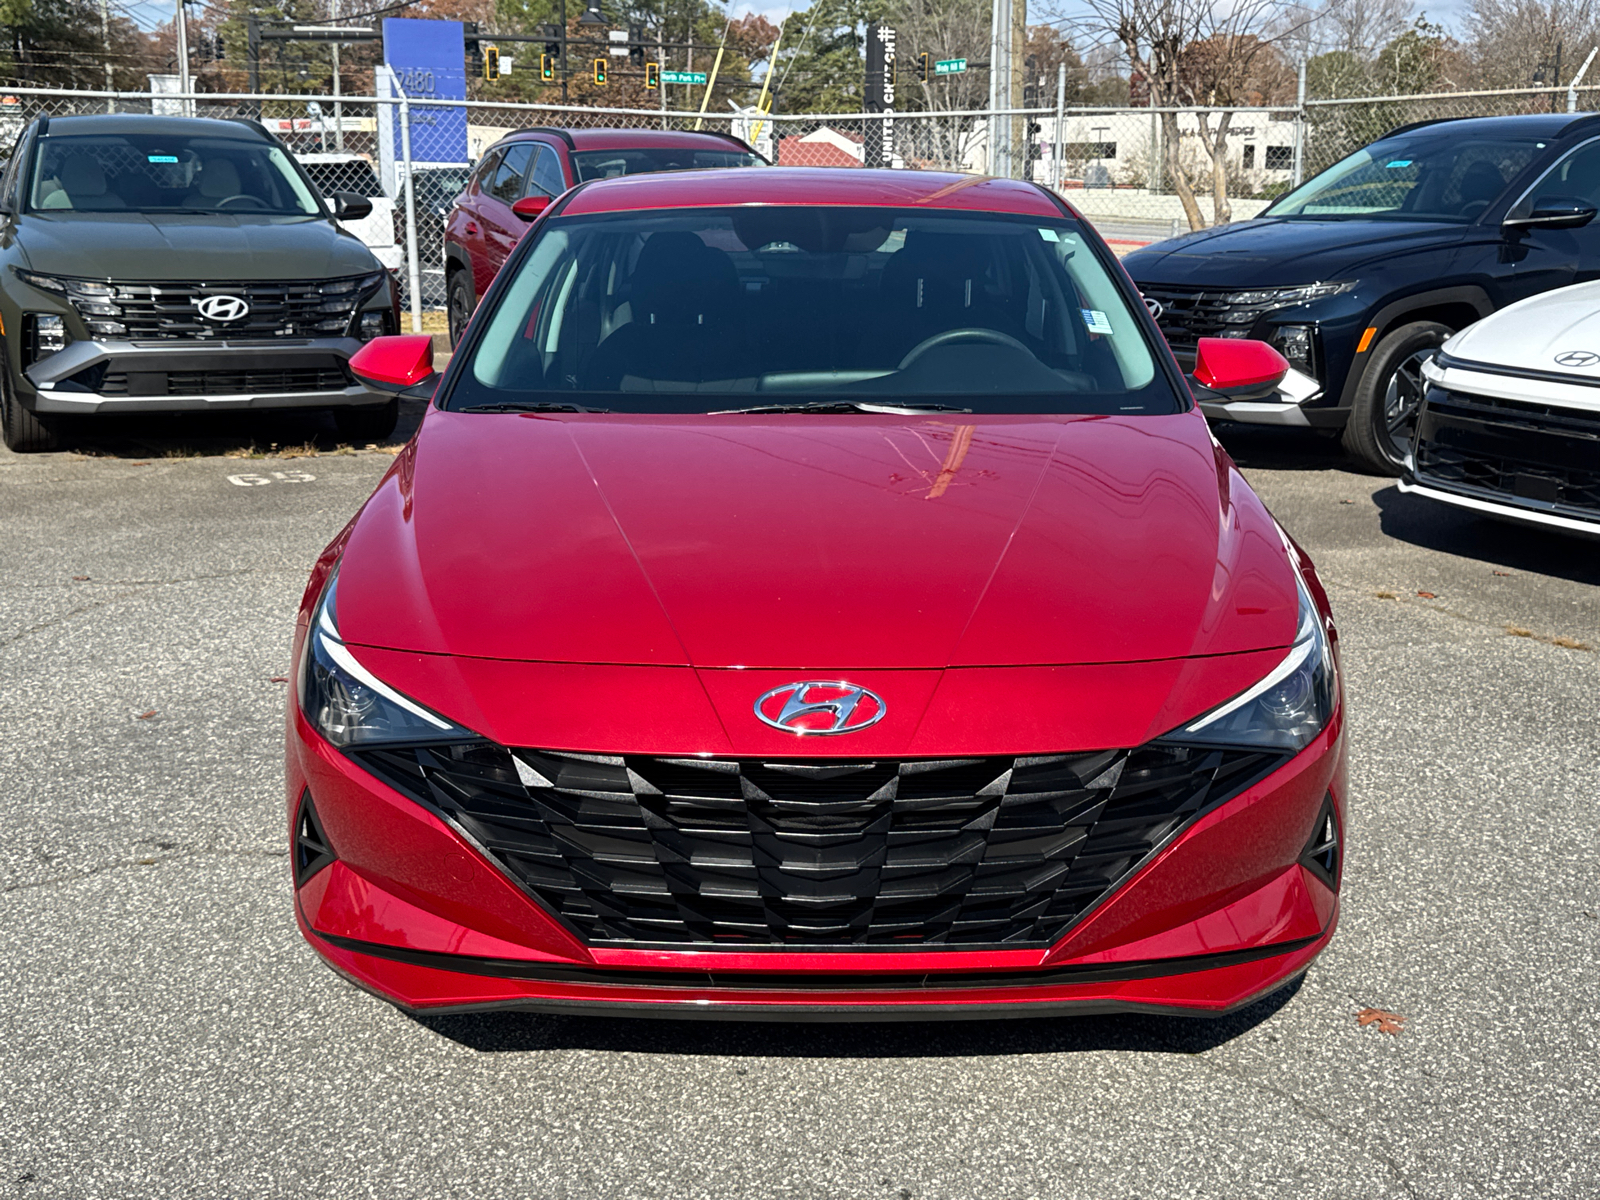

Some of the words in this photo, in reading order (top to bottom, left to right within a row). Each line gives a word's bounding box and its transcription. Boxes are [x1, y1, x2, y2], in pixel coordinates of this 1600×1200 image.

[396, 70, 435, 93] 2480
[661, 73, 677, 81] North
[227, 470, 317, 486] 65
